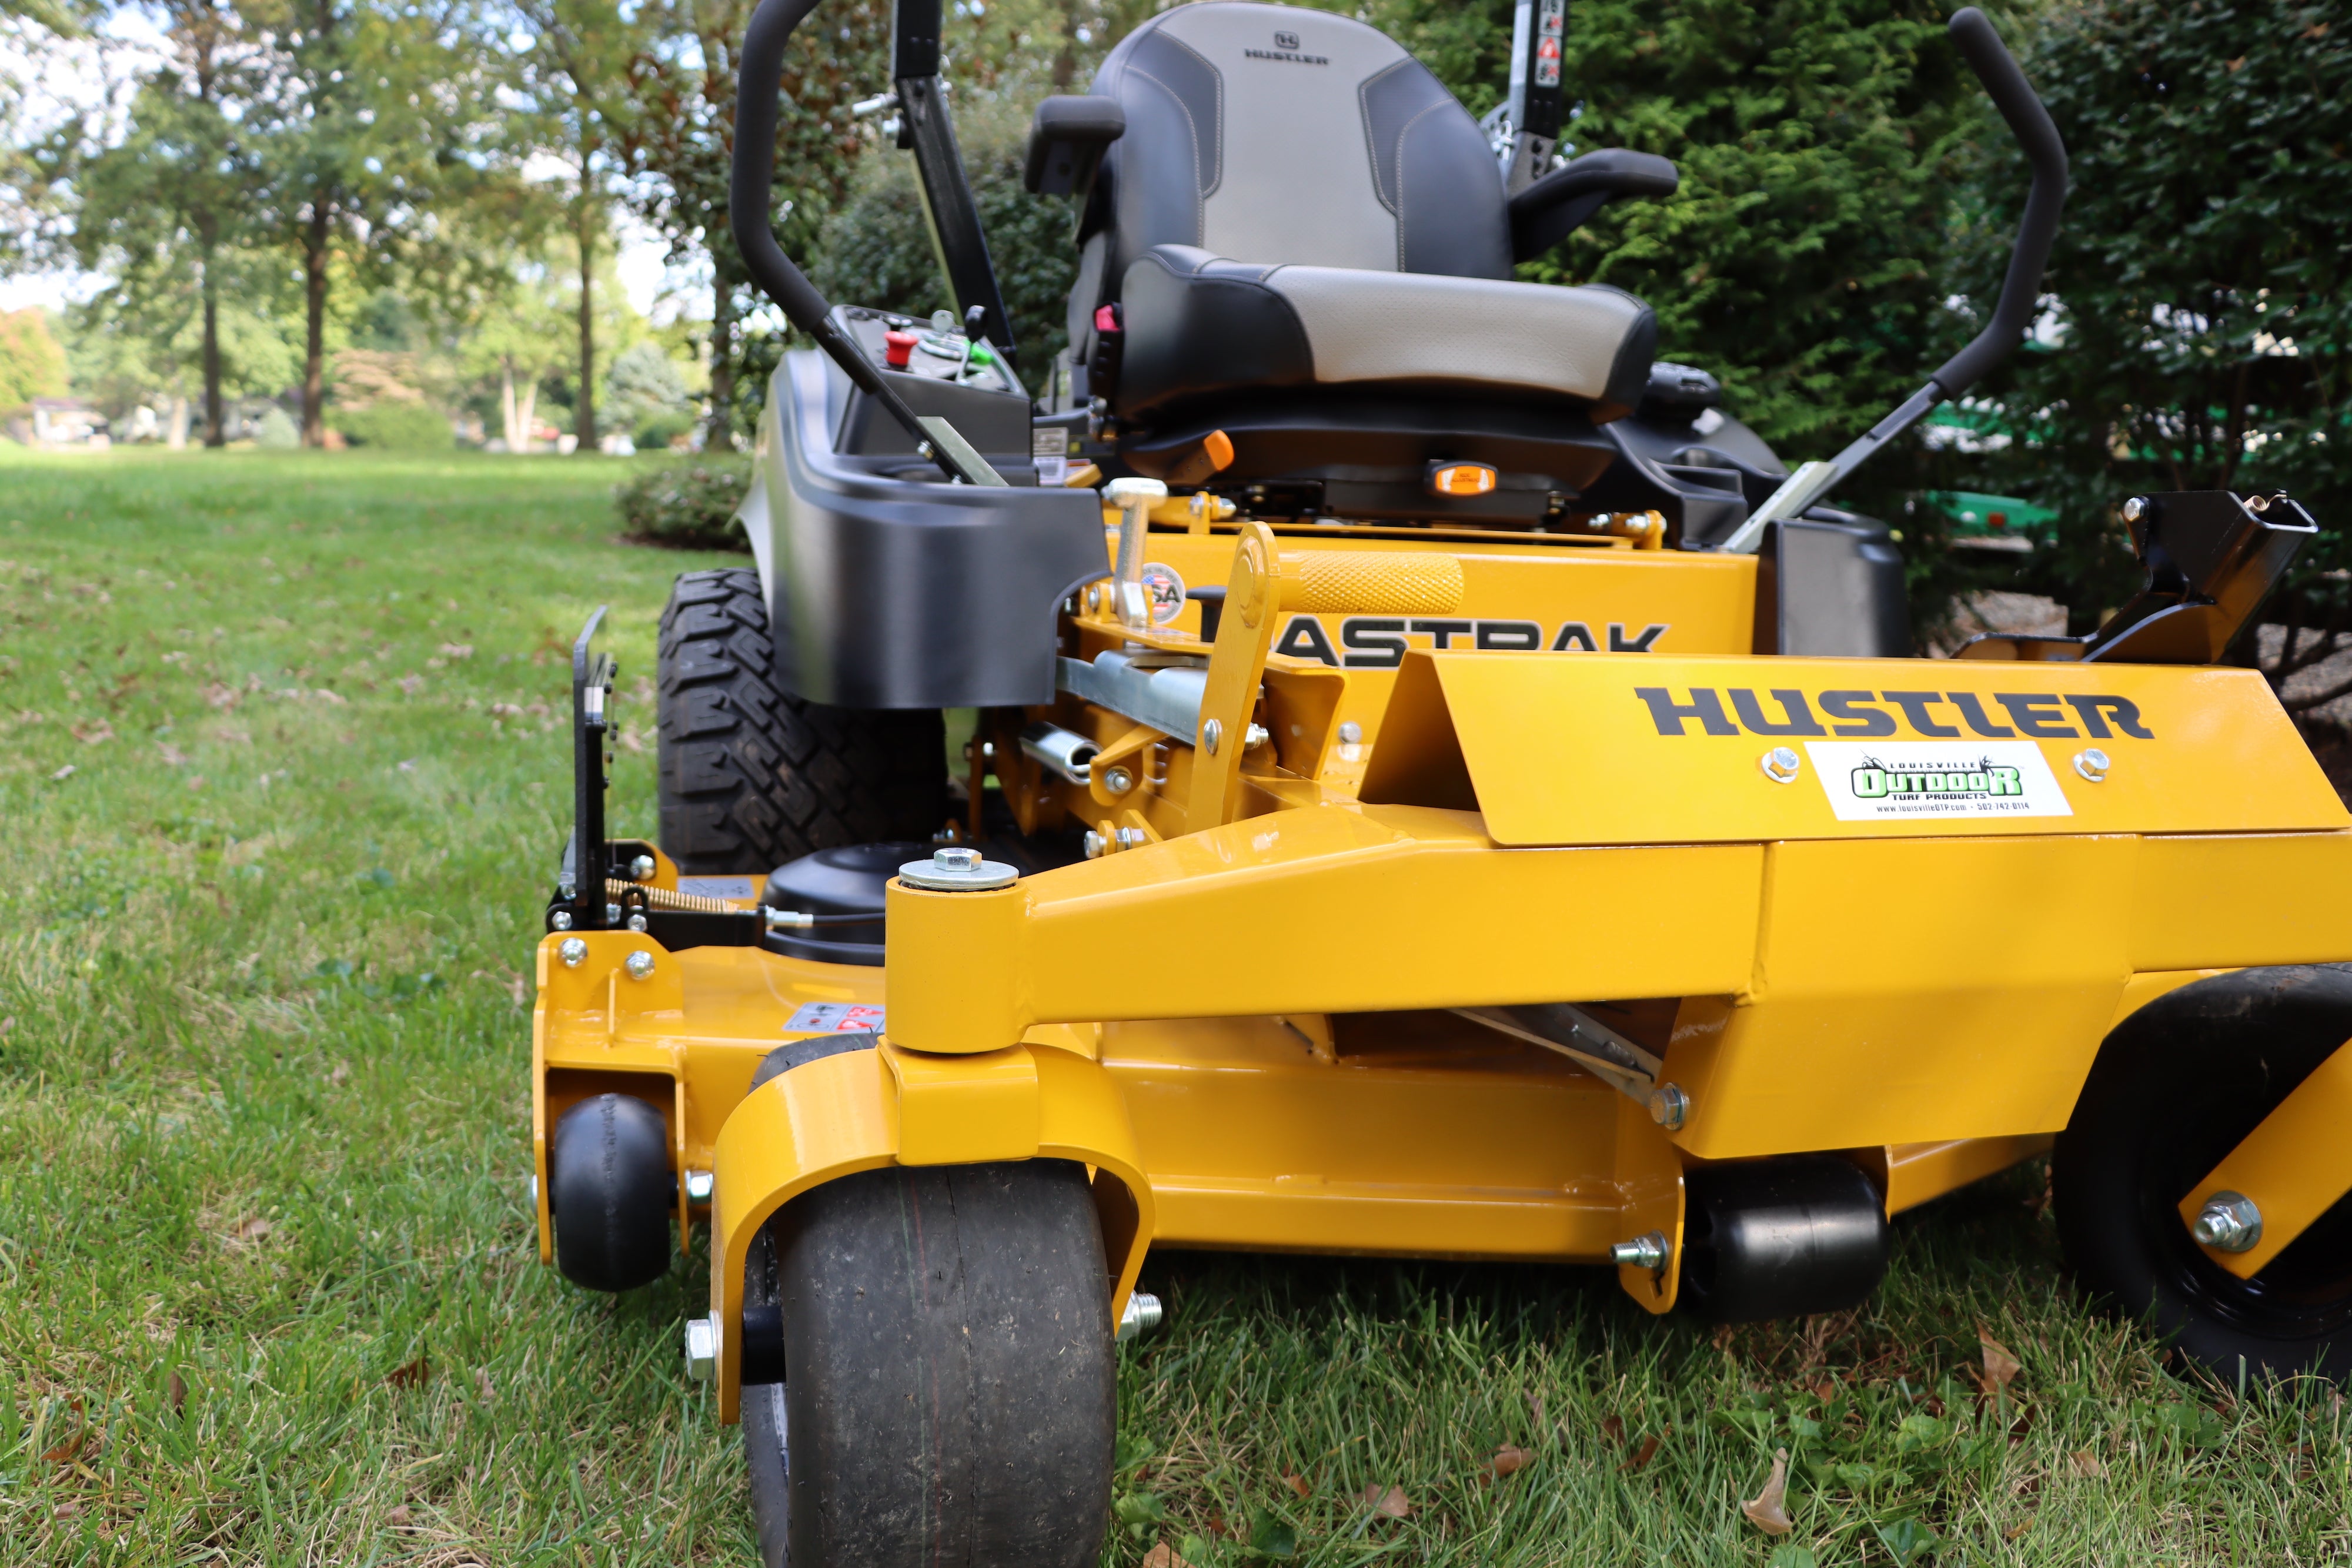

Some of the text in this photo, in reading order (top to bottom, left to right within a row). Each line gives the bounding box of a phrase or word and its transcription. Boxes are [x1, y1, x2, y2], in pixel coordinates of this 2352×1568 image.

[1244, 48, 1328, 65] HUSTLER
[1151, 583, 1181, 603] SA
[1267, 616, 1669, 668] ASTRAK
[1634, 687, 2154, 739] HUSTLER
[1851, 765, 2023, 798] OUTDOOR
[1876, 802, 2030, 813] www.louisvilleOTP.com 502-742-0114
